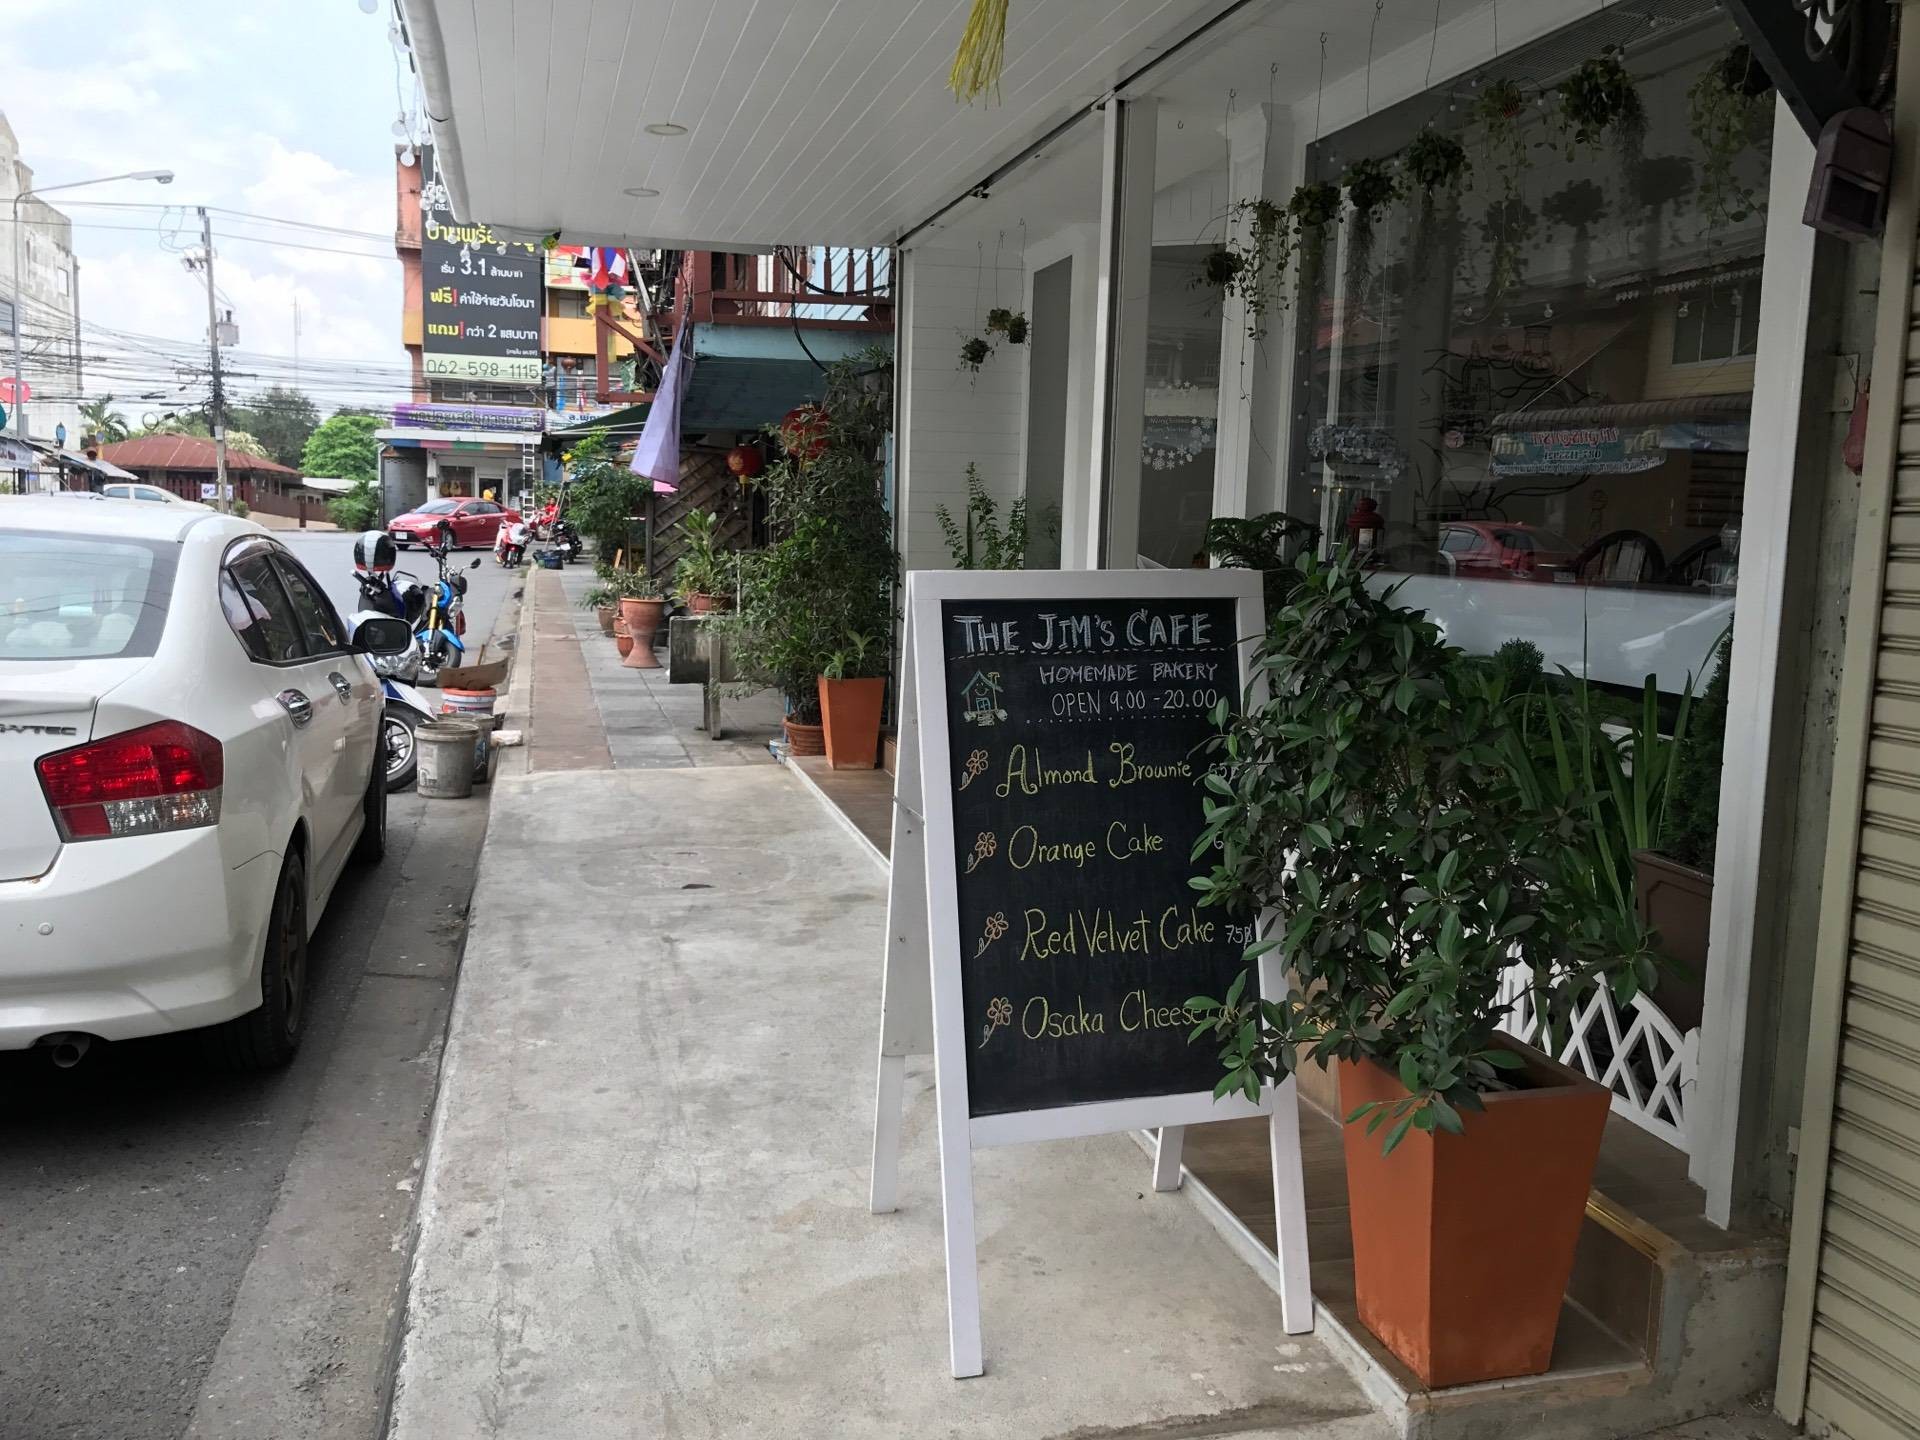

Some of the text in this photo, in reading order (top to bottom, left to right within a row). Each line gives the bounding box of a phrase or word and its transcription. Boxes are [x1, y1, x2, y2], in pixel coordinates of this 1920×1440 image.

[460, 258, 486, 276] 3.1
[466, 326, 484, 337] กว่า
[488, 324, 497, 338] 2
[500, 329, 538, 340] แสนบาท
[426, 360, 539, 379] 062-598-1115
[953, 615, 1020, 652] THE
[1126, 609, 1212, 646] CAFE
[1039, 662, 1218, 685] HOMEMADE BAKERY
[1051, 690, 1101, 716] OPEN
[1109, 689, 1146, 712] 9.00
[995, 744, 1099, 798] Almond
[1108, 742, 1192, 789] Brownie
[1008, 824, 1096, 869] Orange
[1106, 821, 1164, 860] Cake
[1020, 908, 1076, 961] Red
[1078, 907, 1151, 958] Velvet
[1159, 904, 1215, 950] Cake
[1022, 996, 1104, 1039] Osaka
